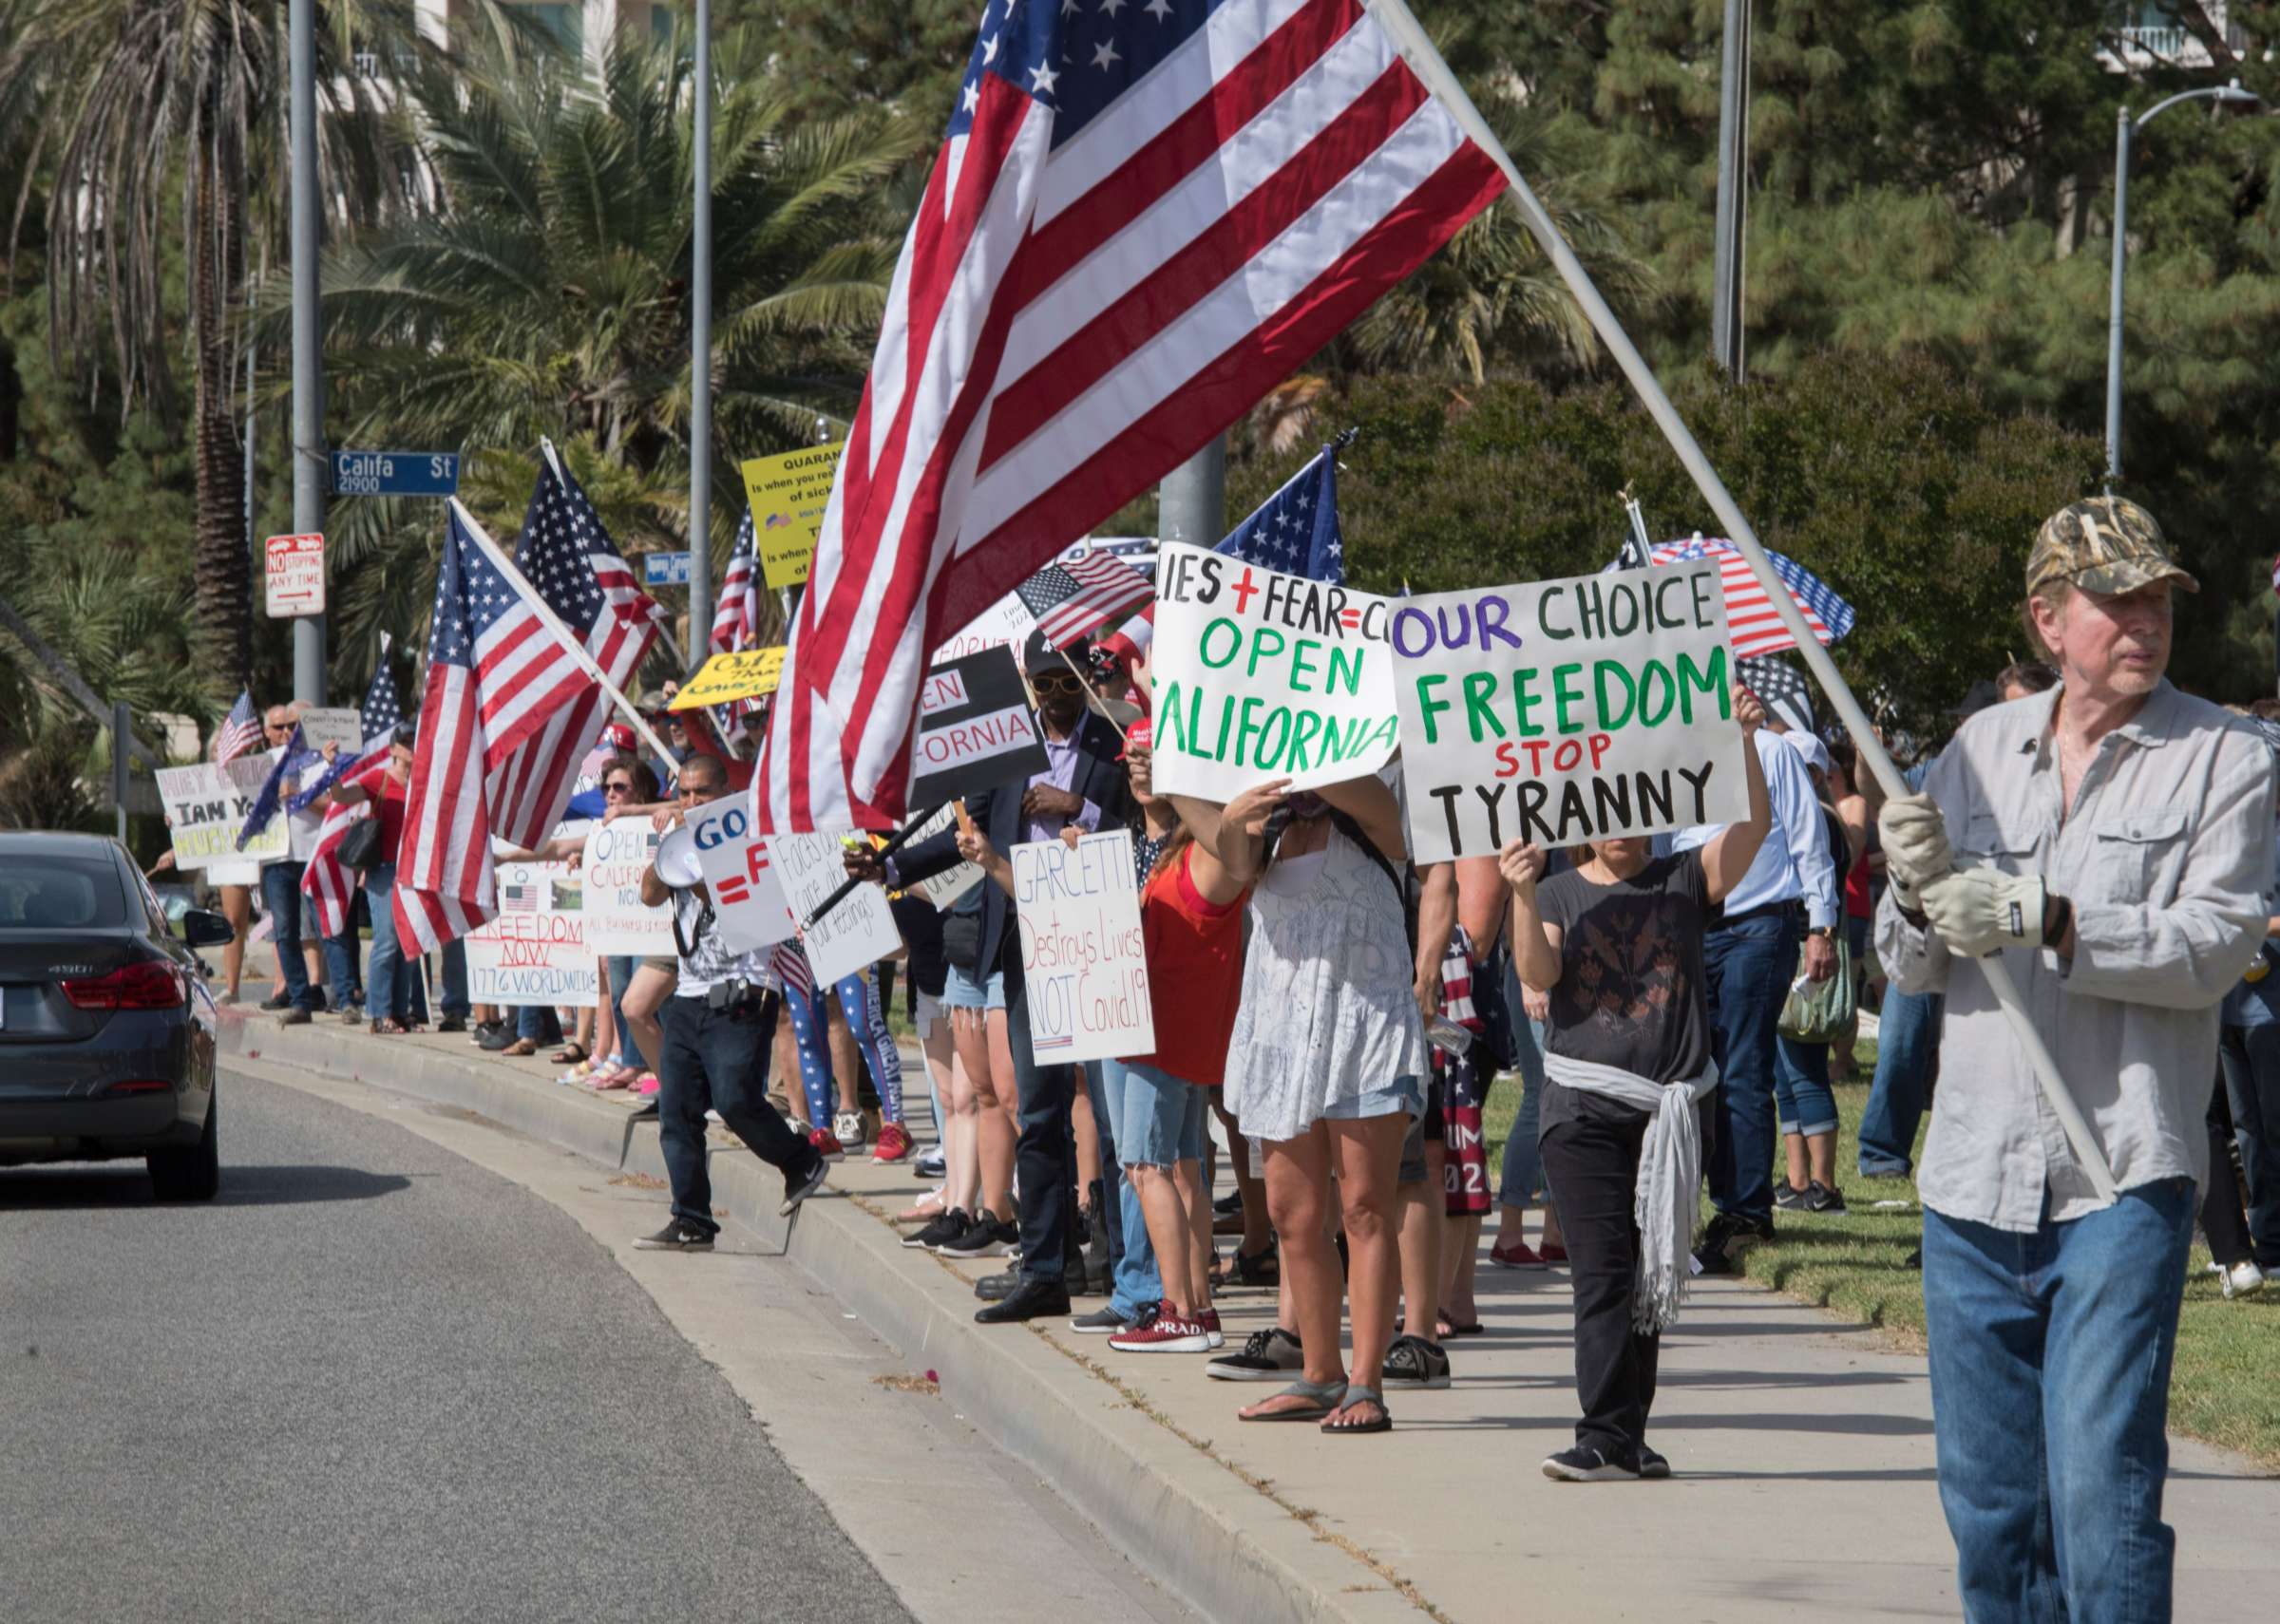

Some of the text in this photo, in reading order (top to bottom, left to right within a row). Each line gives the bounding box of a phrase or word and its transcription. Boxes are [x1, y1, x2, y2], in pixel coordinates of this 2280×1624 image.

[338, 454, 451, 478] Califa St
[338, 476, 380, 492] 21900
[765, 477, 793, 491] when
[796, 474, 815, 486] you
[789, 491, 804, 501] of
[267, 553, 285, 573] NO
[780, 549, 808, 560] when
[270, 574, 320, 588] ANY TIME
[1263, 575, 1348, 640] FEAR
[1393, 595, 1522, 658] OUR
[1538, 572, 1714, 640] CHOICE
[1200, 617, 1365, 696] OPEN
[1416, 646, 1731, 744] FREEDOM
[1494, 733, 1611, 777] STOP
[1430, 761, 1713, 856] TYRANNY
[597, 829, 643, 860] OPEN
[515, 869, 529, 884] Q
[1015, 836, 1132, 903] GARCETTI
[502, 940, 551, 967] NOW
[1019, 908, 1142, 973] Destroys Lives
[472, 968, 598, 996] 1776 WORLDWIDE
[1027, 974, 1075, 1035] NOT
[876, 1032, 901, 1082] GREAT
